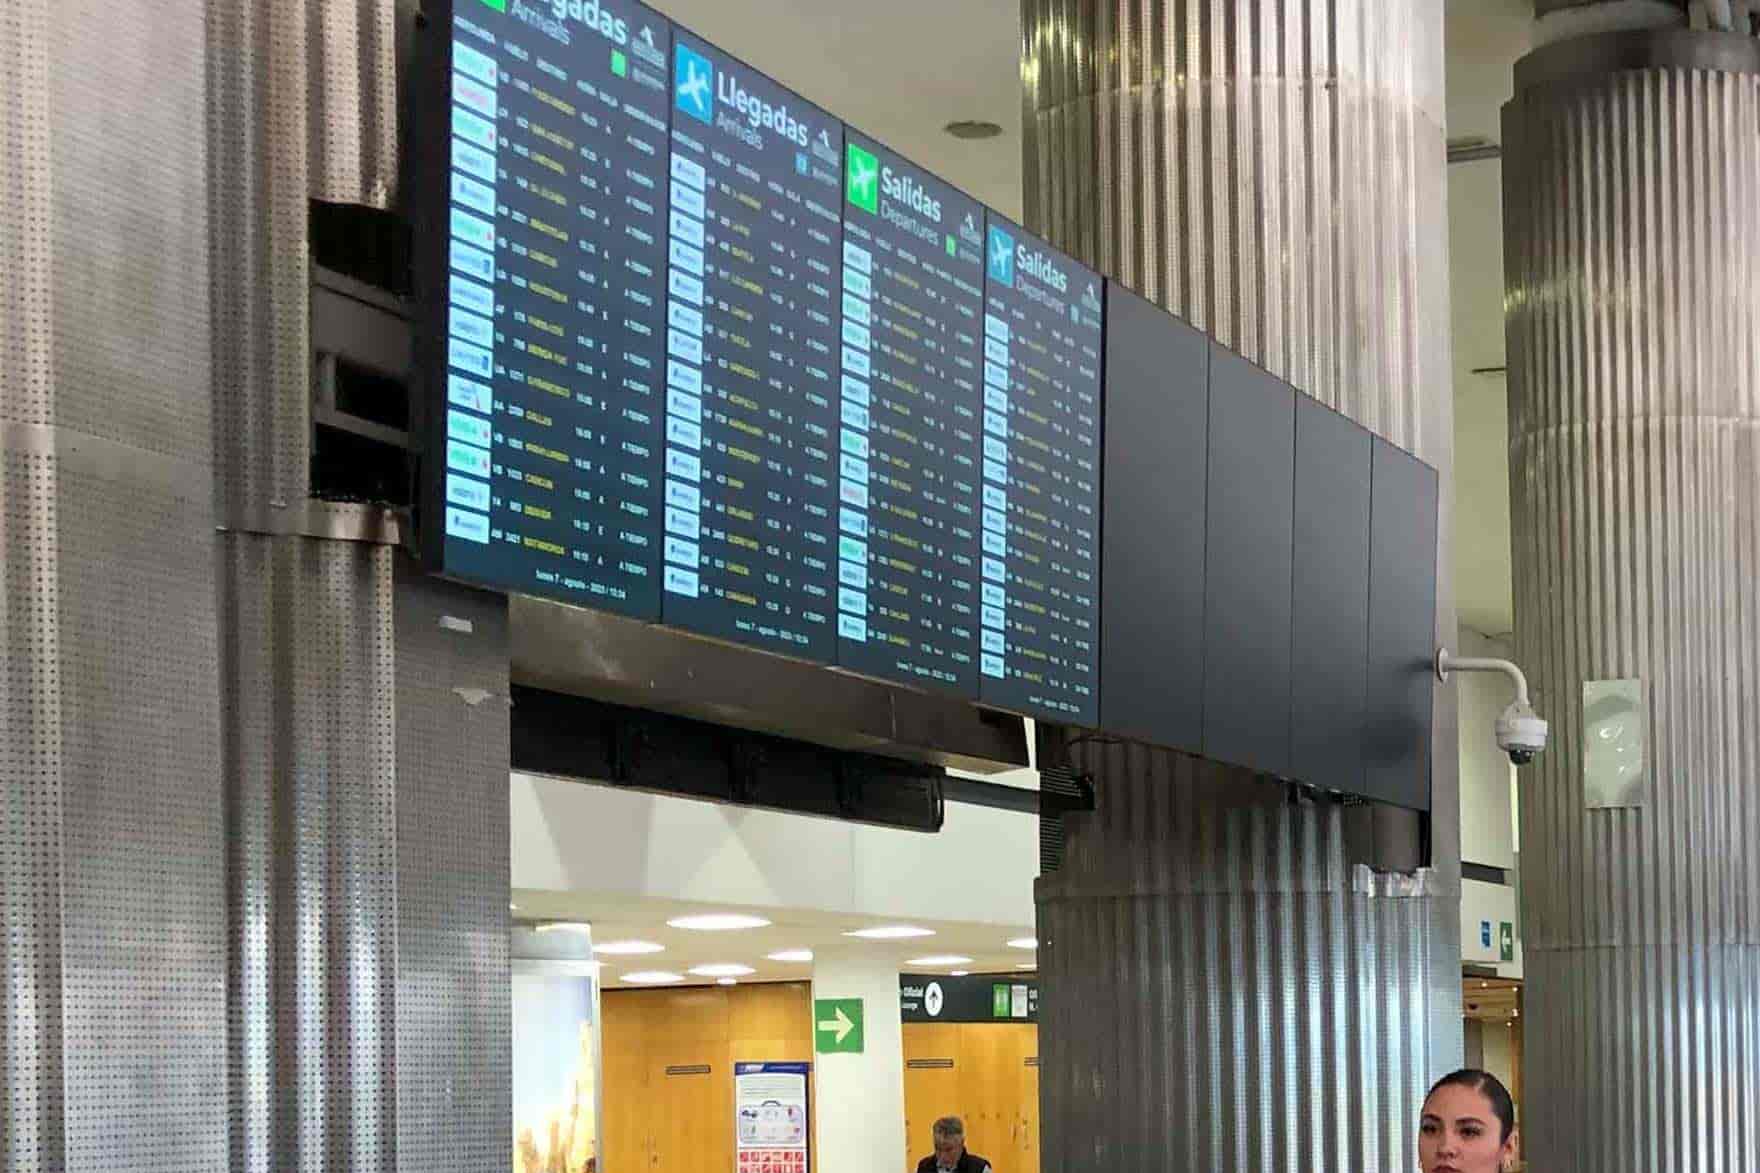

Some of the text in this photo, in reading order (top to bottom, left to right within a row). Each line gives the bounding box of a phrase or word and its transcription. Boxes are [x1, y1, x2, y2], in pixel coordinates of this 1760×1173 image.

[717, 71, 809, 147] Llegadas
[881, 165, 941, 223] Salidas
[880, 199, 939, 247] Departures
[1016, 243, 1067, 292] Salidas
